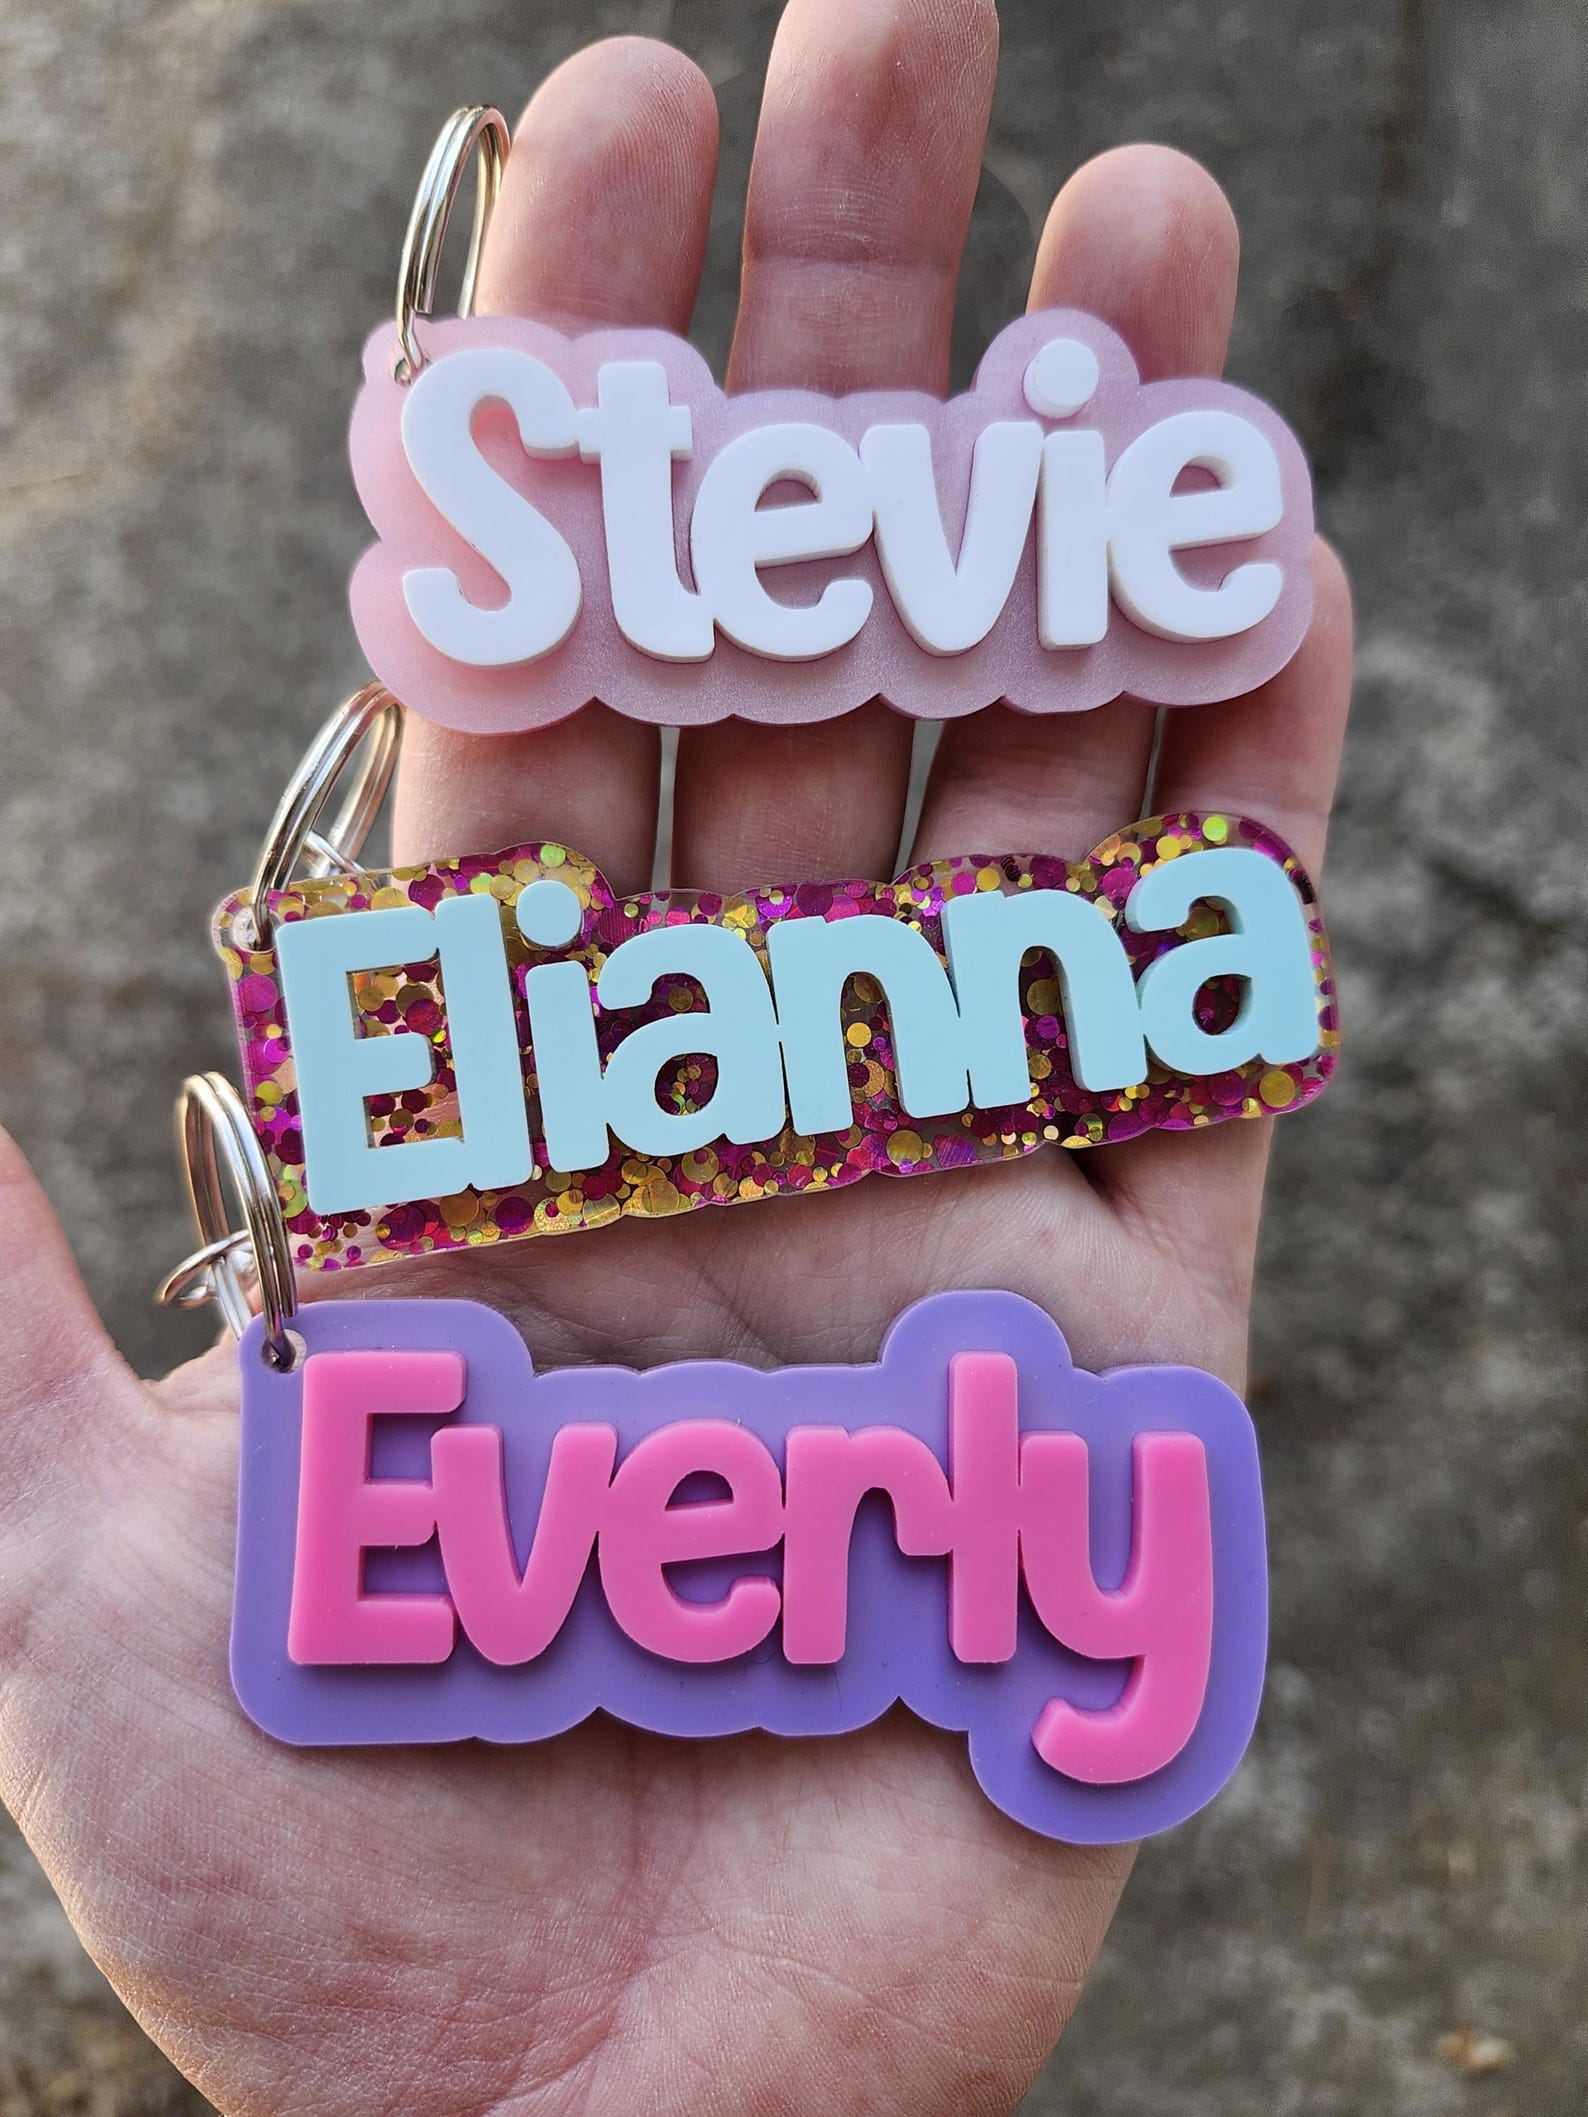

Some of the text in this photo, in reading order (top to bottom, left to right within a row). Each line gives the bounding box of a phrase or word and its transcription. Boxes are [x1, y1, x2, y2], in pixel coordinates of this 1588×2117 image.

[401, 338, 1282, 664] Stevie
[275, 847, 1320, 1216] Elianna
[287, 1352, 1213, 1784] Everly
